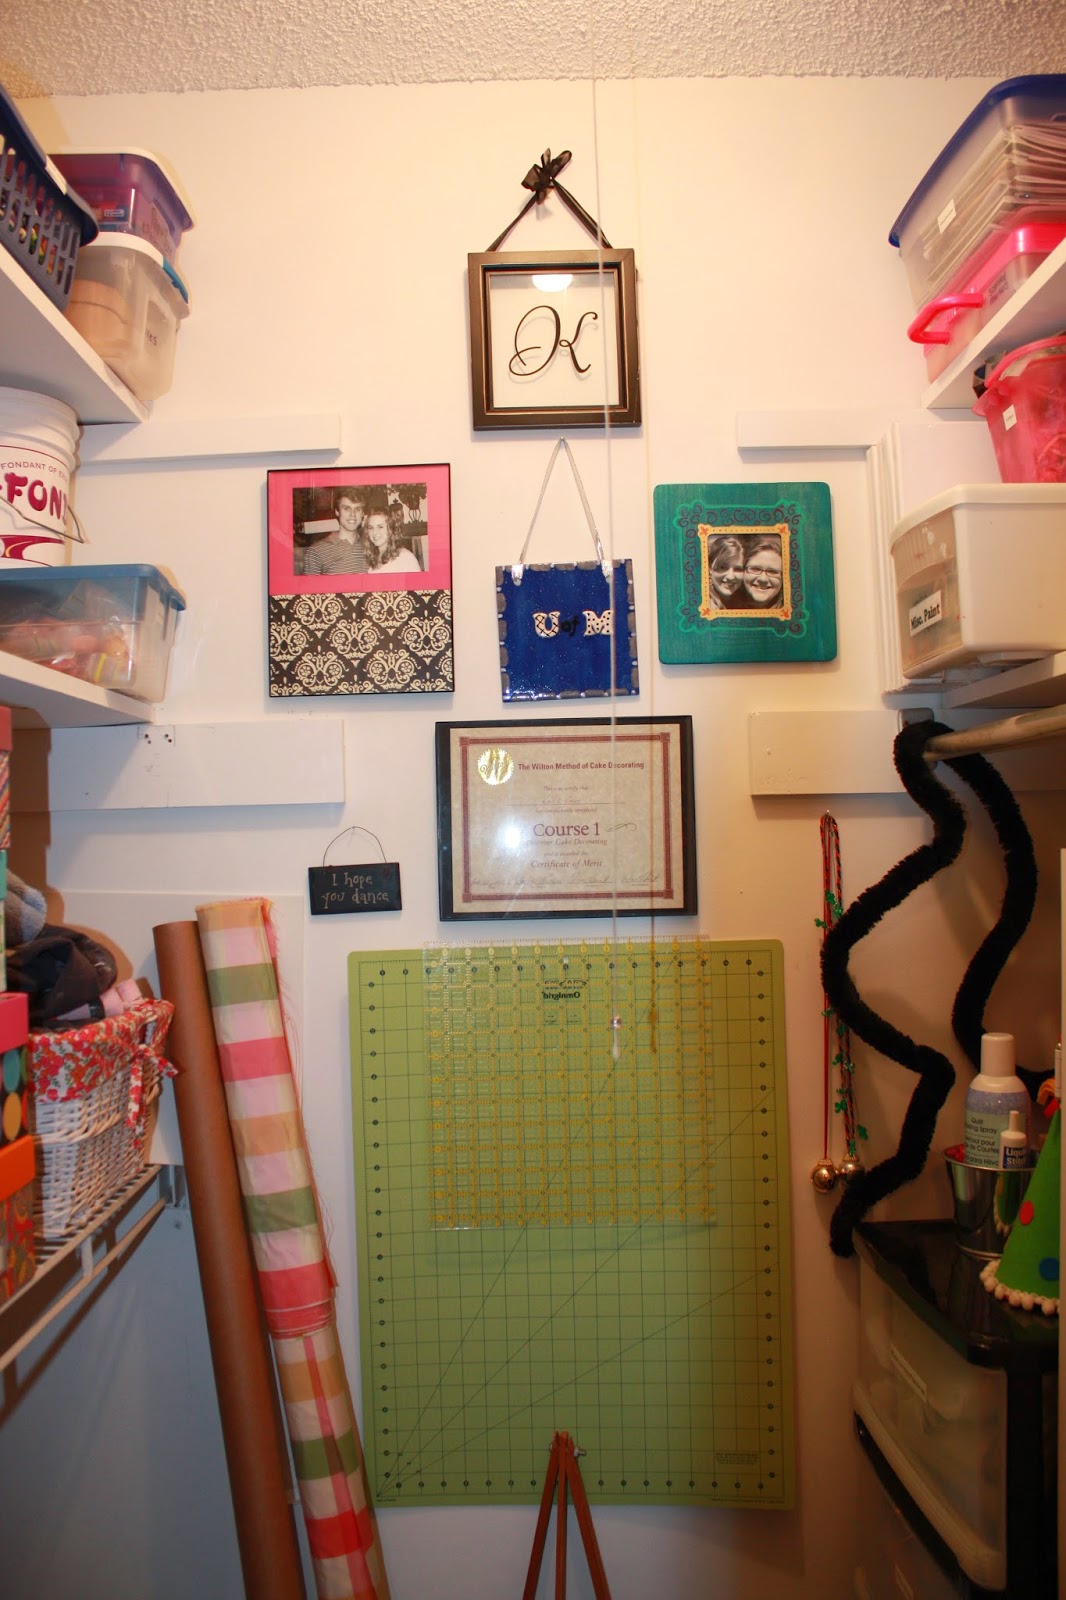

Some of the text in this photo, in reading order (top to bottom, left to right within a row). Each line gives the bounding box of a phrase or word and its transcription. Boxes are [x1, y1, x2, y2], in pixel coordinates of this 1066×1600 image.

[0, 462, 46, 470] FONDANT
[924, 603, 940, 622] Paint
[518, 763, 530, 771] The
[555, 762, 580, 770] Method
[533, 822, 601, 837] Course 1
[555, 838, 572, 846] Cake
[574, 838, 608, 847] Decorating
[530, 859, 603, 869] Certificate of Merit
[331, 872, 373, 889] I hope
[321, 888, 389, 909] you dance
[979, 1126, 998, 1135] Spray
